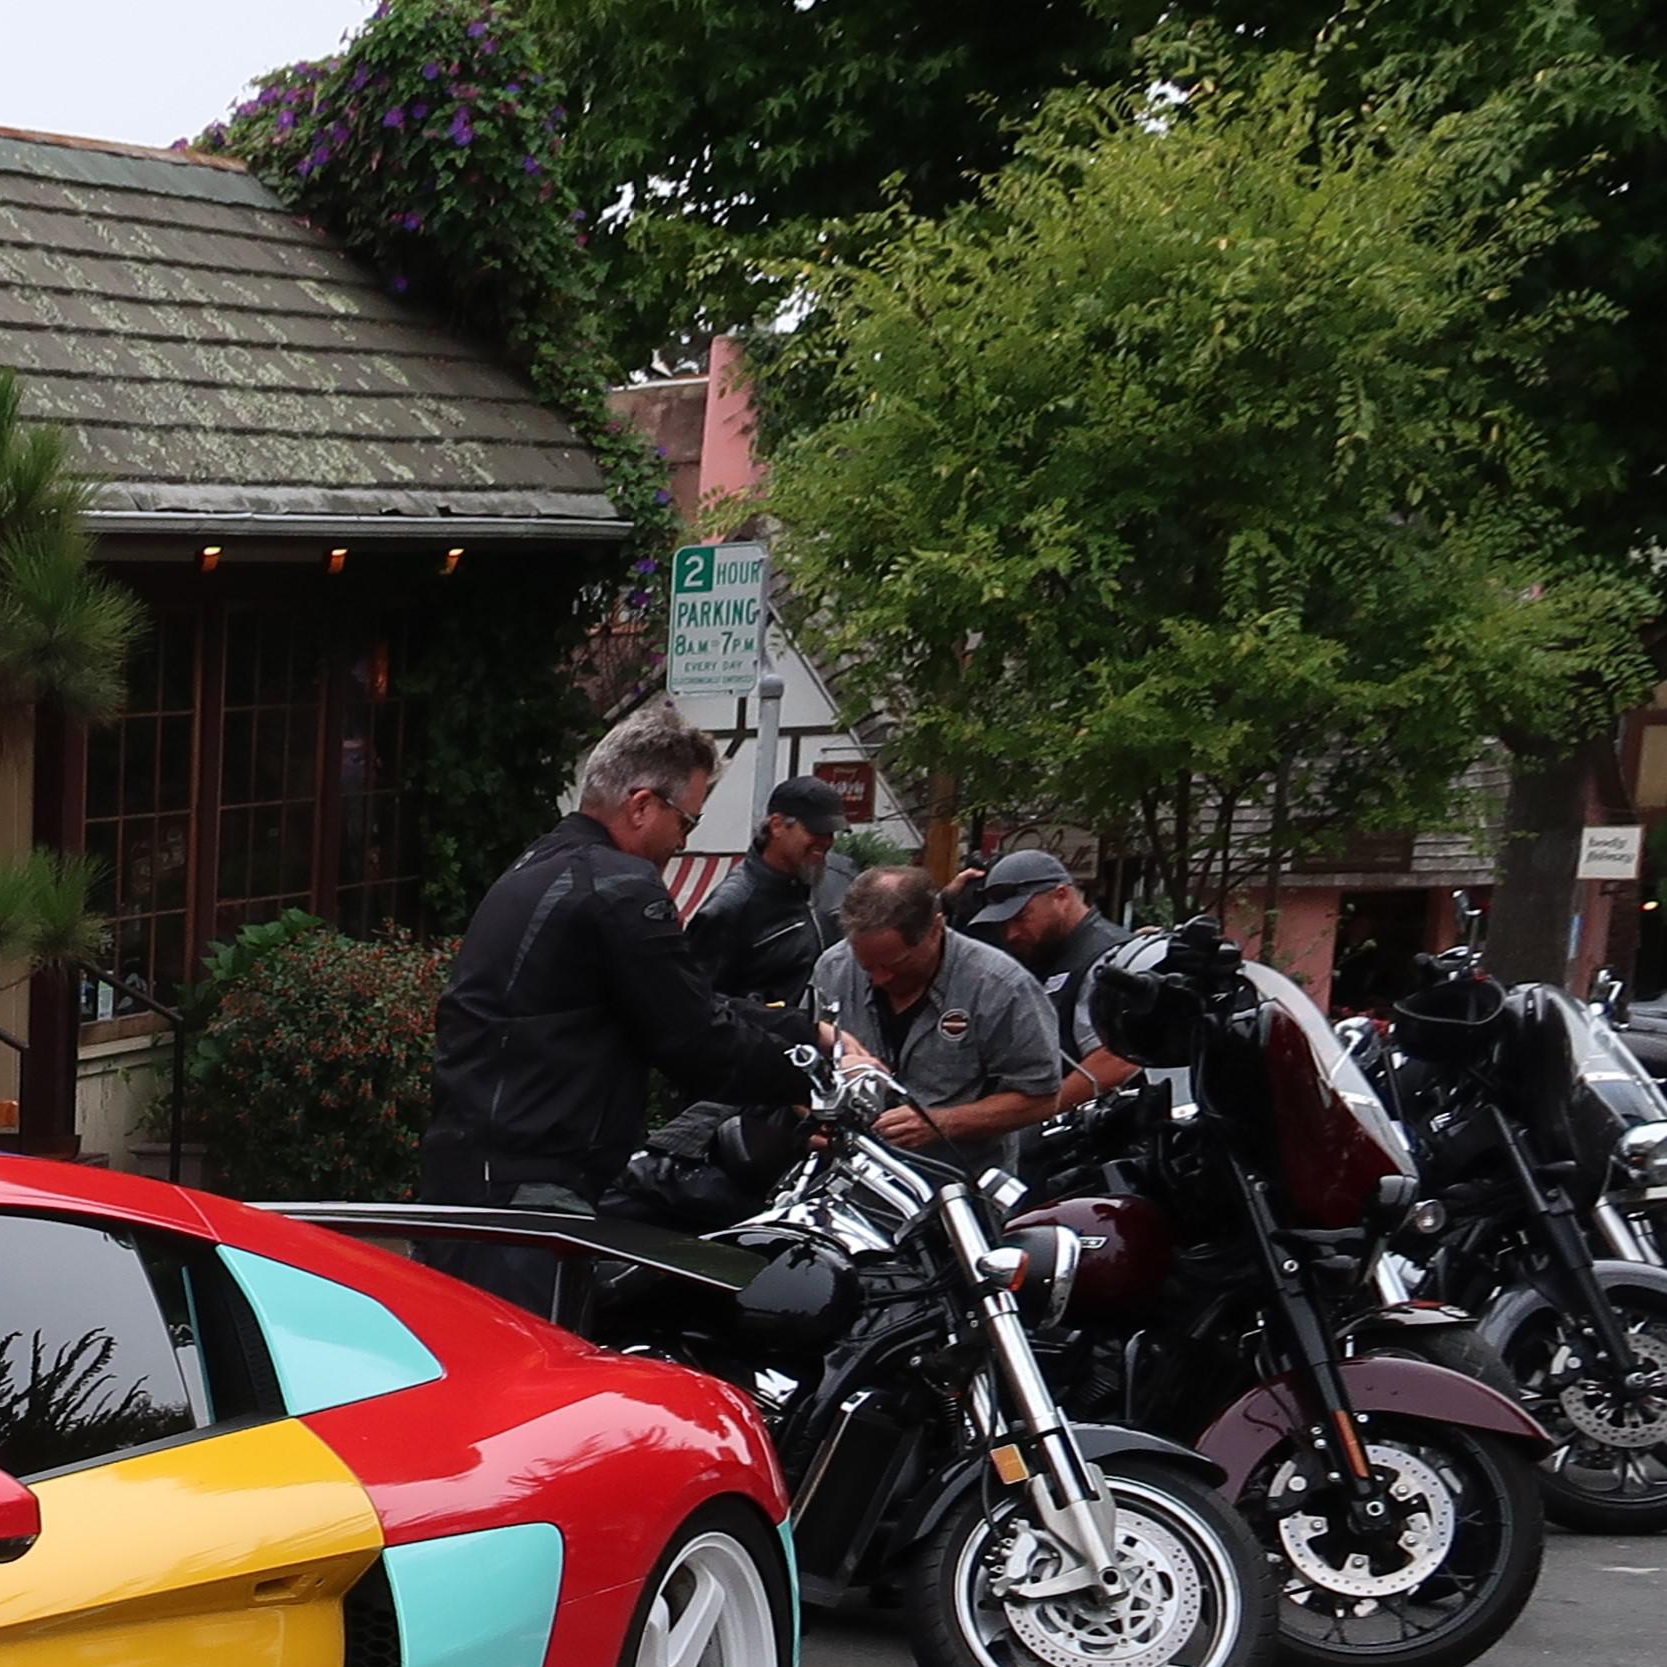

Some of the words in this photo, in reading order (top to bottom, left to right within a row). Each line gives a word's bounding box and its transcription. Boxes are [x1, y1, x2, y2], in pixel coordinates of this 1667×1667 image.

[683, 555, 704, 588] 2
[716, 561, 761, 585] HOUR
[677, 598, 758, 628] PARKING
[684, 660, 717, 672] EVERY
[722, 660, 744, 671] DAY
